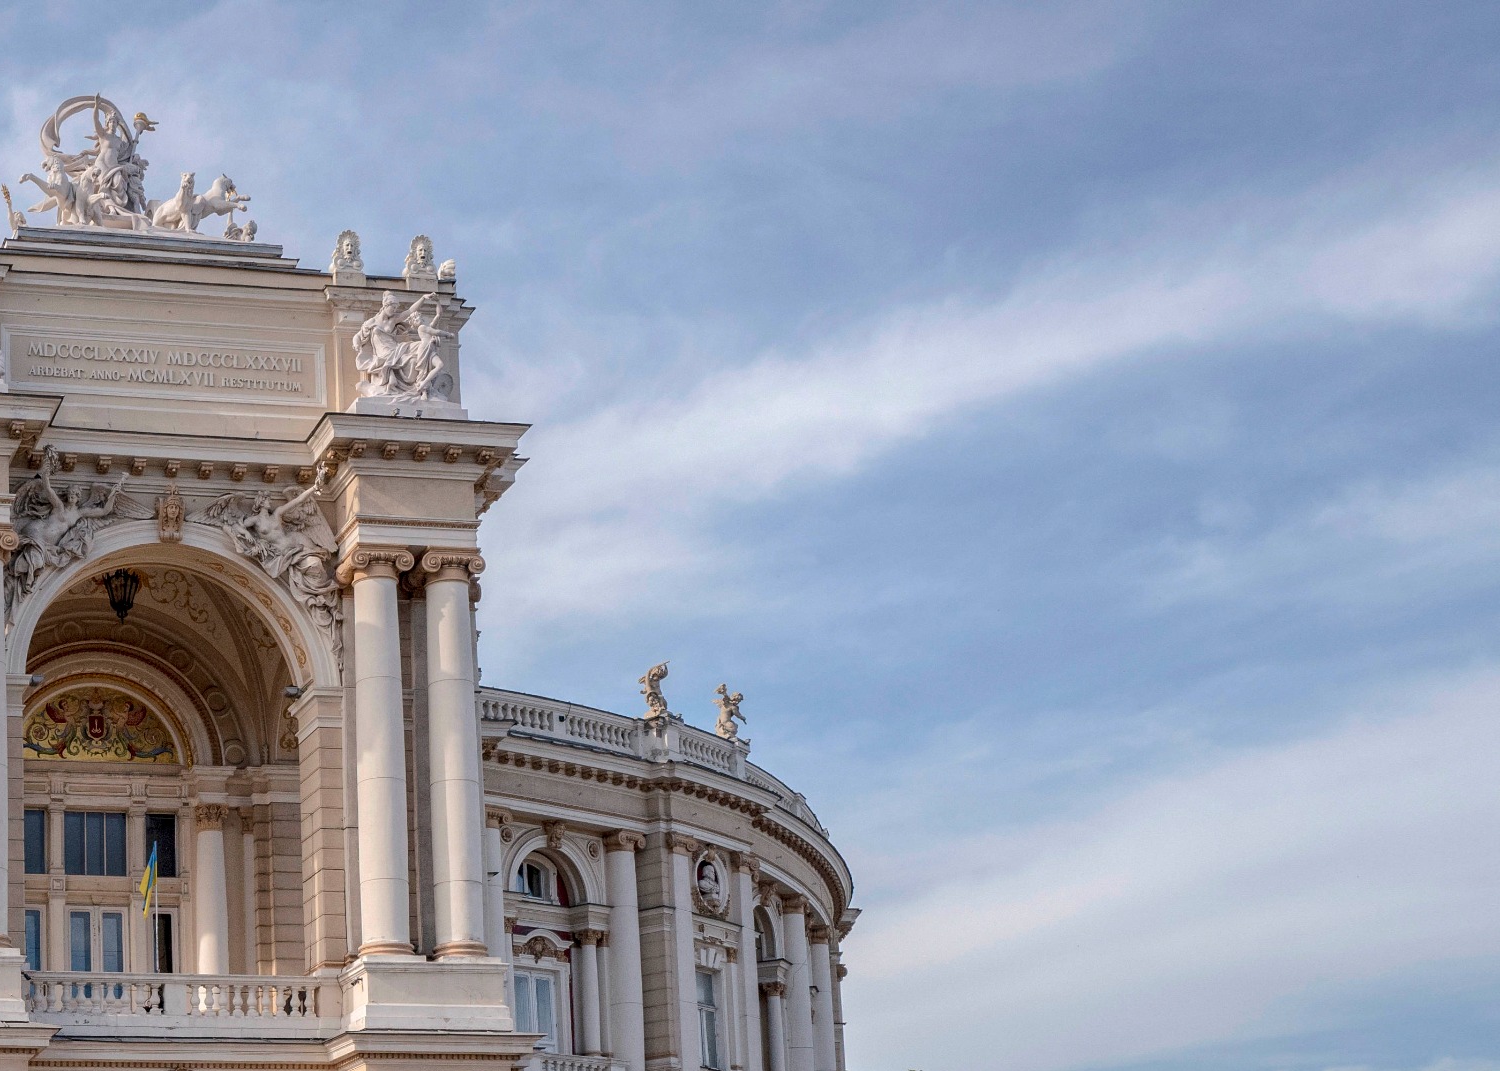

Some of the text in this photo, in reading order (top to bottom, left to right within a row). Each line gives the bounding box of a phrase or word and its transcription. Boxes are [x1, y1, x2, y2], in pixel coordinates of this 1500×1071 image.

[28, 341, 302, 373] MDCCCLXXXIV MDCCCLXXXVII
[221, 376, 303, 393] RESTITUTUM
